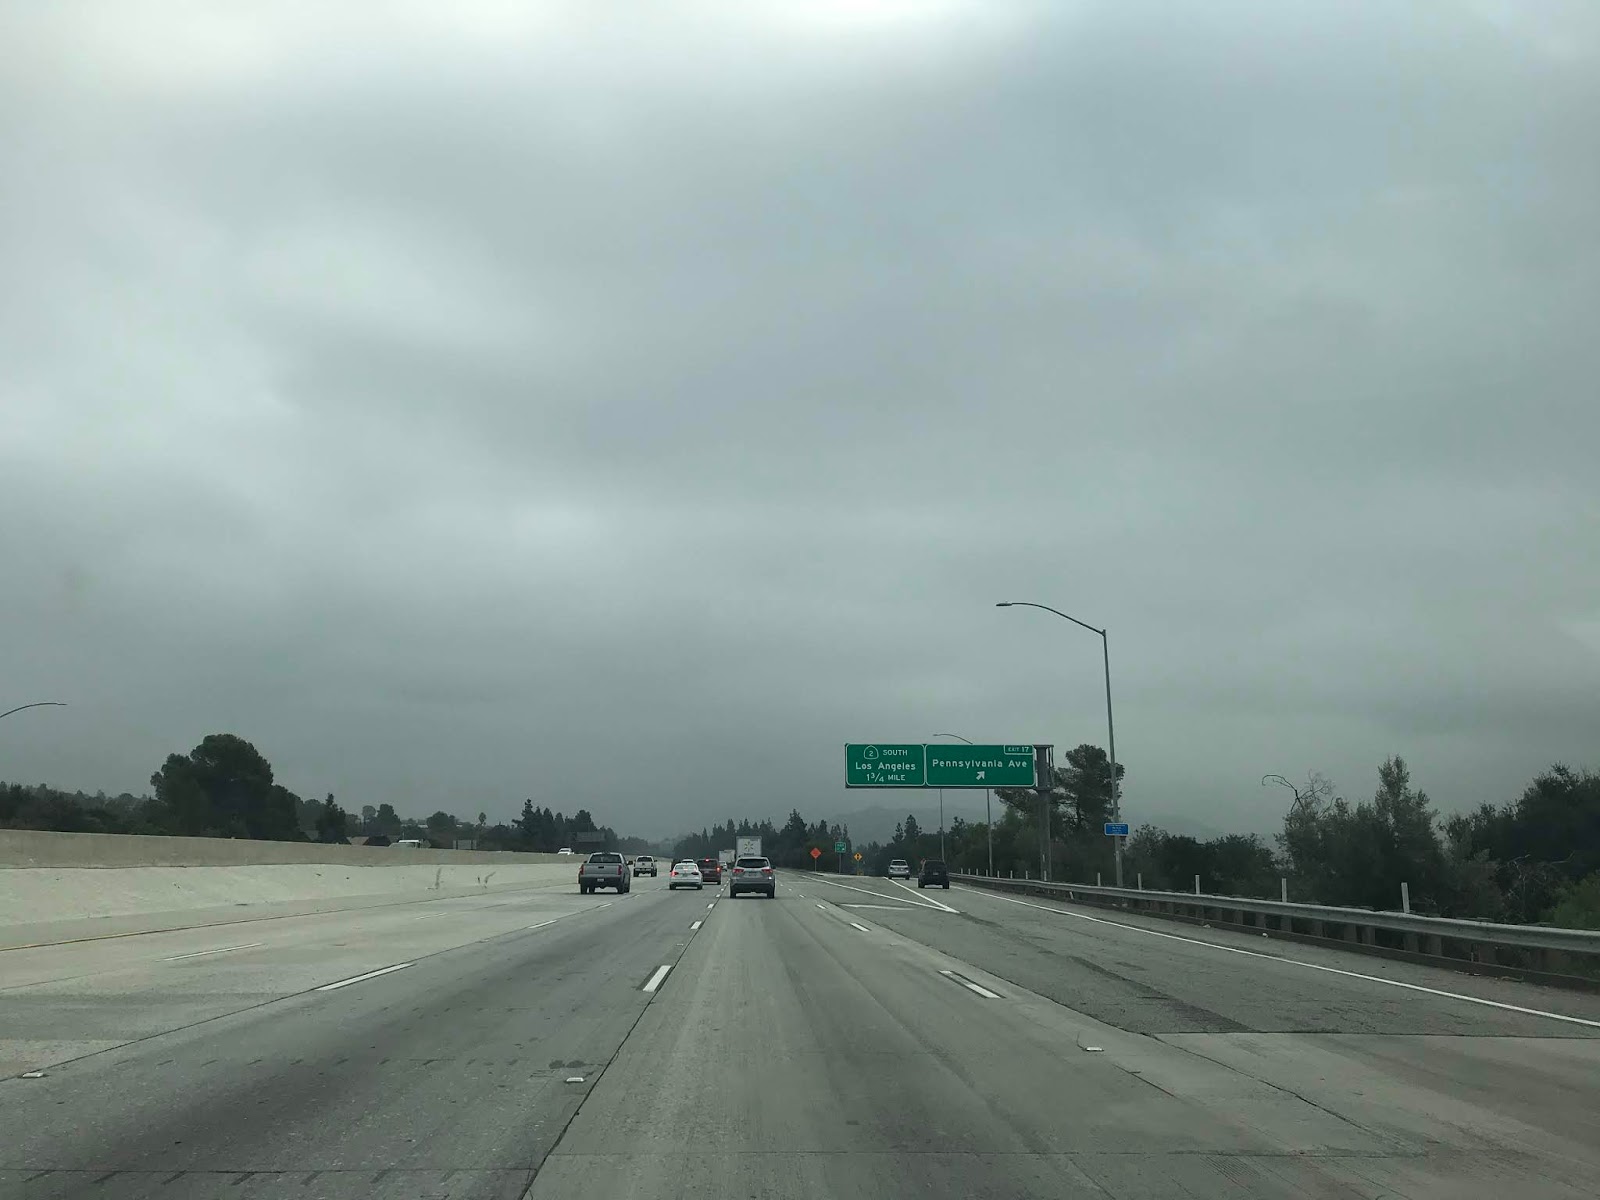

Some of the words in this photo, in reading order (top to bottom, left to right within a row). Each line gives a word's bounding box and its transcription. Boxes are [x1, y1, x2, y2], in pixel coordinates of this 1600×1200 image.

[855, 761, 872, 770] Los
[878, 761, 916, 772] Angeles
[932, 759, 1003, 769] Pennsylvania
[1008, 759, 1028, 768] Ave
